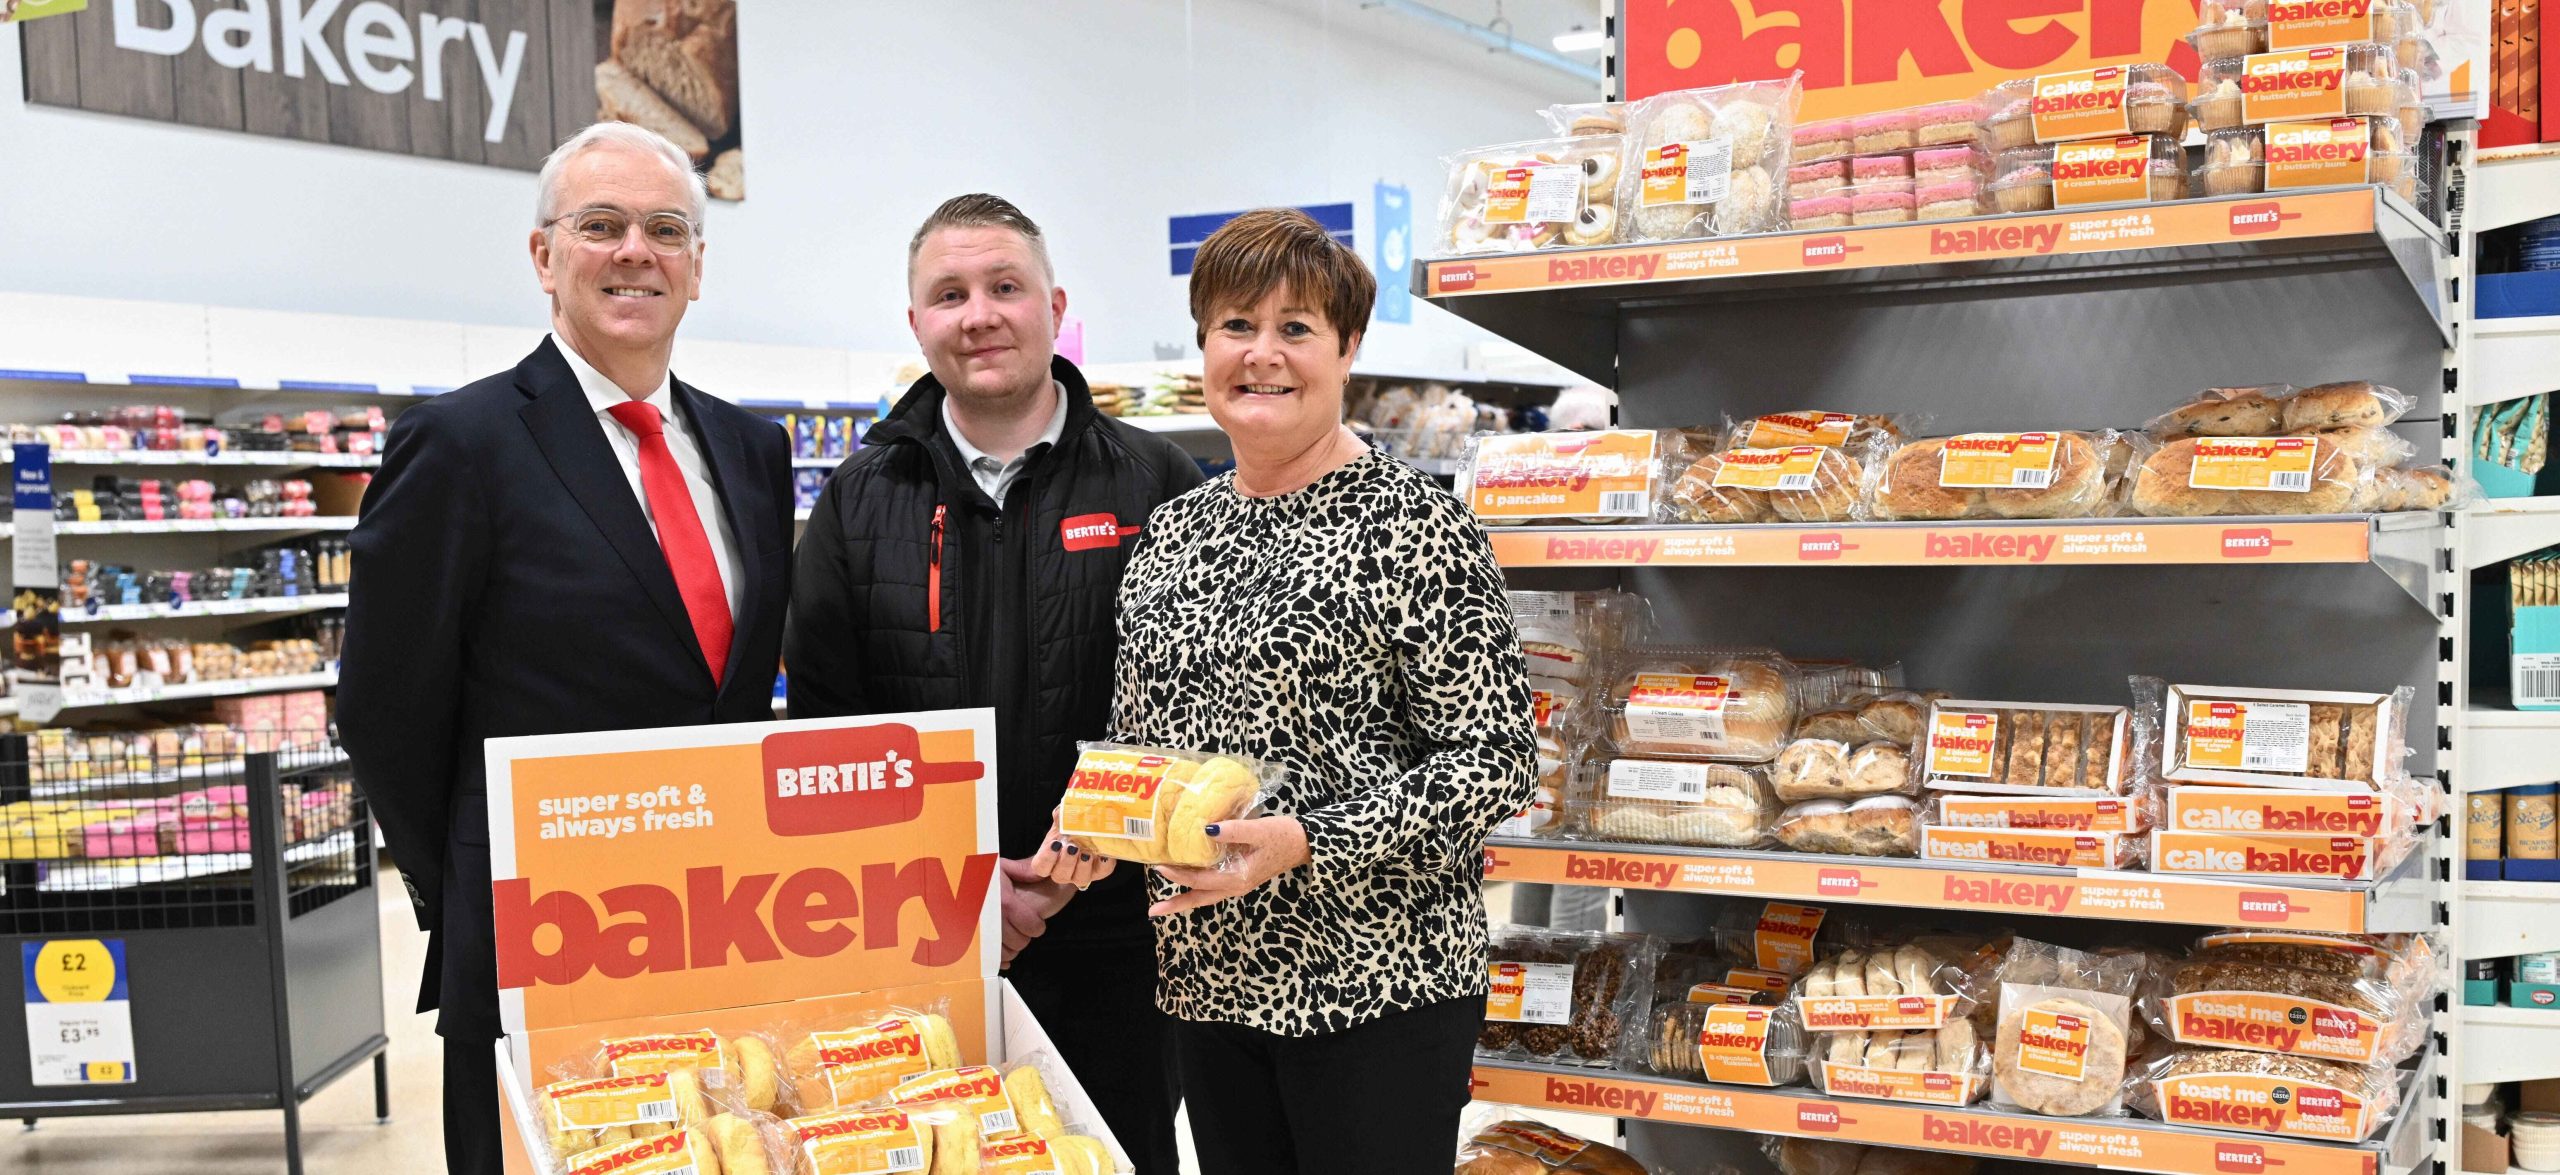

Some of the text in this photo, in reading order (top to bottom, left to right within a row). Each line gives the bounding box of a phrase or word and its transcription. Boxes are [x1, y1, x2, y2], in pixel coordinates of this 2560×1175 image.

[2268, 0, 2371, 22] bakery
[2327, 17, 2350, 26] buns
[112, 0, 527, 143] Bakery
[2252, 59, 2309, 75] cake
[2041, 79, 2093, 97] cake
[2241, 68, 2345, 93] bakery
[2032, 88, 2126, 114] bakery
[2260, 89, 2323, 101] butterfly buns
[2049, 112, 2074, 121] cream
[2274, 130, 2331, 145] cake
[2062, 147, 2116, 162] cake
[2265, 141, 2369, 163] bakery
[1641, 165, 1687, 179] bakery
[2052, 157, 2149, 180] bakery
[2283, 160, 2346, 171] butterfly buns
[1487, 188, 1531, 199] bakery
[2069, 216, 2139, 231] super soft
[2233, 210, 2278, 224] BERTIE'S
[1930, 223, 2063, 255] bakery
[2069, 225, 2154, 242] always fresh
[1666, 246, 1726, 262] super soft
[1805, 243, 1844, 257] BERTIE'S
[1548, 253, 1662, 282] bakery
[1665, 256, 1738, 271] always fresh
[1441, 270, 1474, 283] BERTIE'S
[1759, 414, 1818, 432] bakery
[1945, 439, 2020, 453] bakery
[1959, 450, 1980, 458] plain
[2193, 445, 2276, 458] bakery
[1724, 452, 1790, 464] bakery
[1484, 493, 1566, 507] 6 pancakes
[1065, 521, 1116, 540] BERTIE'S
[2063, 532, 2130, 544] super soft
[1663, 536, 1724, 548] super soft
[1802, 540, 1840, 551] BERTIE'S
[1925, 532, 2057, 562] bakery
[2062, 542, 2147, 554] always fresh
[2225, 535, 2270, 547] BERTIE'S
[1546, 537, 1659, 563] bakery
[1663, 546, 1735, 557] always fresh
[1939, 723, 1977, 736] treat
[2193, 716, 2232, 727] cake
[2188, 725, 2245, 741] bakery
[1932, 734, 1994, 753] bakery
[1081, 757, 1135, 772] brioche
[776, 749, 914, 799] BERTIE'S
[1067, 769, 1164, 800] bakery
[538, 783, 707, 818] super soft &
[1074, 791, 1104, 801] brioche
[539, 806, 714, 839] always fresh
[1949, 809, 2094, 831] treat bakery
[2182, 805, 2384, 837] cake bakery
[1930, 838, 2072, 866] treat bakery
[1565, 854, 1679, 888] bakery
[1683, 863, 1743, 876] super soft
[2165, 847, 2366, 879] cake bakery
[1683, 873, 1755, 886] always fresh
[1821, 876, 1859, 888] BERTIE'S
[1943, 875, 2075, 913] bakery
[2080, 886, 2148, 898] super soft
[2080, 896, 2164, 910] always fresh
[2242, 900, 2287, 913] BERTIE'S
[492, 852, 999, 990] bakery
[1756, 918, 1818, 940] bakery
[62, 953, 87, 971] £2
[1491, 984, 1525, 996] akery
[1813, 1000, 1856, 1013] soda
[2192, 999, 2283, 1023] toast me
[1808, 1012, 1871, 1027] bakery
[1903, 1015, 1930, 1023] sodas
[61, 1028, 100, 1043] £3.95
[1709, 1022, 1745, 1034] cake
[2031, 1024, 2071, 1040] soda
[2183, 1012, 2302, 1052] bakery
[823, 1032, 882, 1048] brioche
[1700, 1031, 1766, 1051] bakery
[2020, 1029, 2088, 1057] bakery
[2300, 1039, 2366, 1056] wheaten
[605, 1037, 717, 1062] bakery
[819, 1033, 921, 1068] bakery
[875, 1056, 907, 1068] muffins
[1836, 1068, 1880, 1084] soda
[550, 1072, 669, 1099] bakery
[899, 1075, 961, 1098] brioche
[1830, 1078, 1895, 1097] bakery
[1926, 1091, 1955, 1099] sodas
[2178, 1081, 2268, 1104] toast me
[1545, 1077, 1658, 1118] bakery
[1663, 1092, 1721, 1105] super soft
[2272, 1092, 2290, 1100] taste
[2299, 1096, 2341, 1109] BERTIE'S
[1662, 1102, 1735, 1117] always fresh
[1800, 1110, 1838, 1124] BERTIE'S
[2171, 1095, 2286, 1132] bakery
[2301, 1112, 2346, 1124] toaster
[797, 1113, 909, 1141] bakery
[2286, 1119, 2351, 1134] wheaten
[822, 1130, 895, 1145] brioche muffins
[1922, 1114, 2052, 1157] bakery
[2058, 1131, 2126, 1145] super soft
[982, 1139, 1047, 1158] kery
[2058, 1141, 2142, 1158] always fresh
[2218, 1150, 2262, 1166] BERTIE'S
